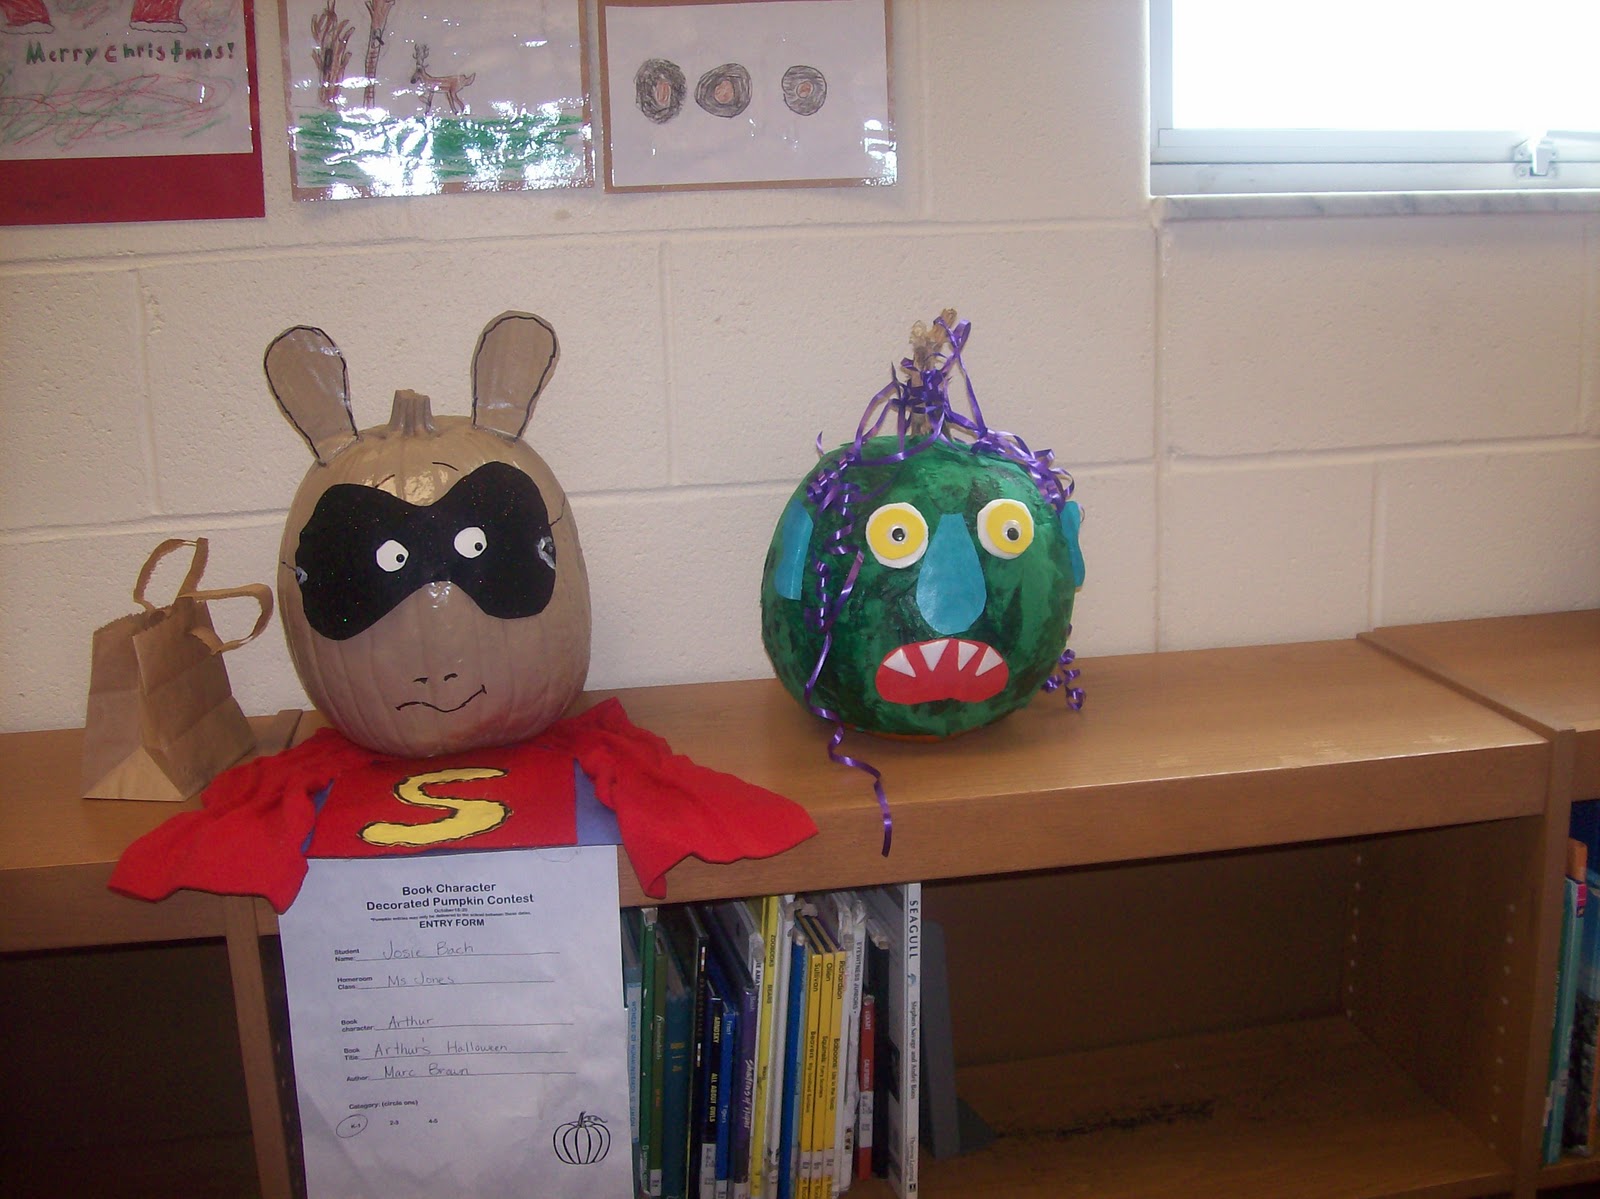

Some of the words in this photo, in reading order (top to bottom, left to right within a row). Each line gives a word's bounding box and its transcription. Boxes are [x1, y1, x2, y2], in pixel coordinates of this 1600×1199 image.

[26, 41, 98, 65] Merry
[357, 767, 513, 847] S
[402, 886, 433, 896] Book
[436, 883, 496, 893] Character
[366, 897, 430, 911] Decorated
[433, 896, 484, 907] Pumpkin
[487, 893, 534, 905] Contest
[419, 920, 453, 929] ENTRY
[455, 918, 485, 927] FORM
[908, 900, 919, 960] SEAGULL
[436, 941, 474, 955] Bach
[854, 941, 863, 981] EYEWITNESS
[337, 975, 373, 983] Homeroom
[414, 971, 456, 987] Jones
[813, 963, 821, 992] Sullivan
[837, 960, 846, 1000] Richardson
[766, 984, 774, 1004] BEARS
[852, 983, 860, 1010] JUNIORS
[388, 1015, 434, 1029] Arthur
[909, 1001, 918, 1027] Stephen
[712, 1016, 721, 1044] ARNOSKY
[909, 1027, 918, 1049] Savage
[374, 1038, 431, 1058] Arthur's
[447, 1040, 508, 1053] Halloween
[910, 1051, 918, 1063] and
[384, 1065, 416, 1079] Marc
[711, 1073, 719, 1083] ALL
[710, 1085, 718, 1104] ABOUT
[349, 1102, 381, 1110] Category:
[709, 1106, 717, 1123] OWLS
[721, 1105, 729, 1124] Tigers
